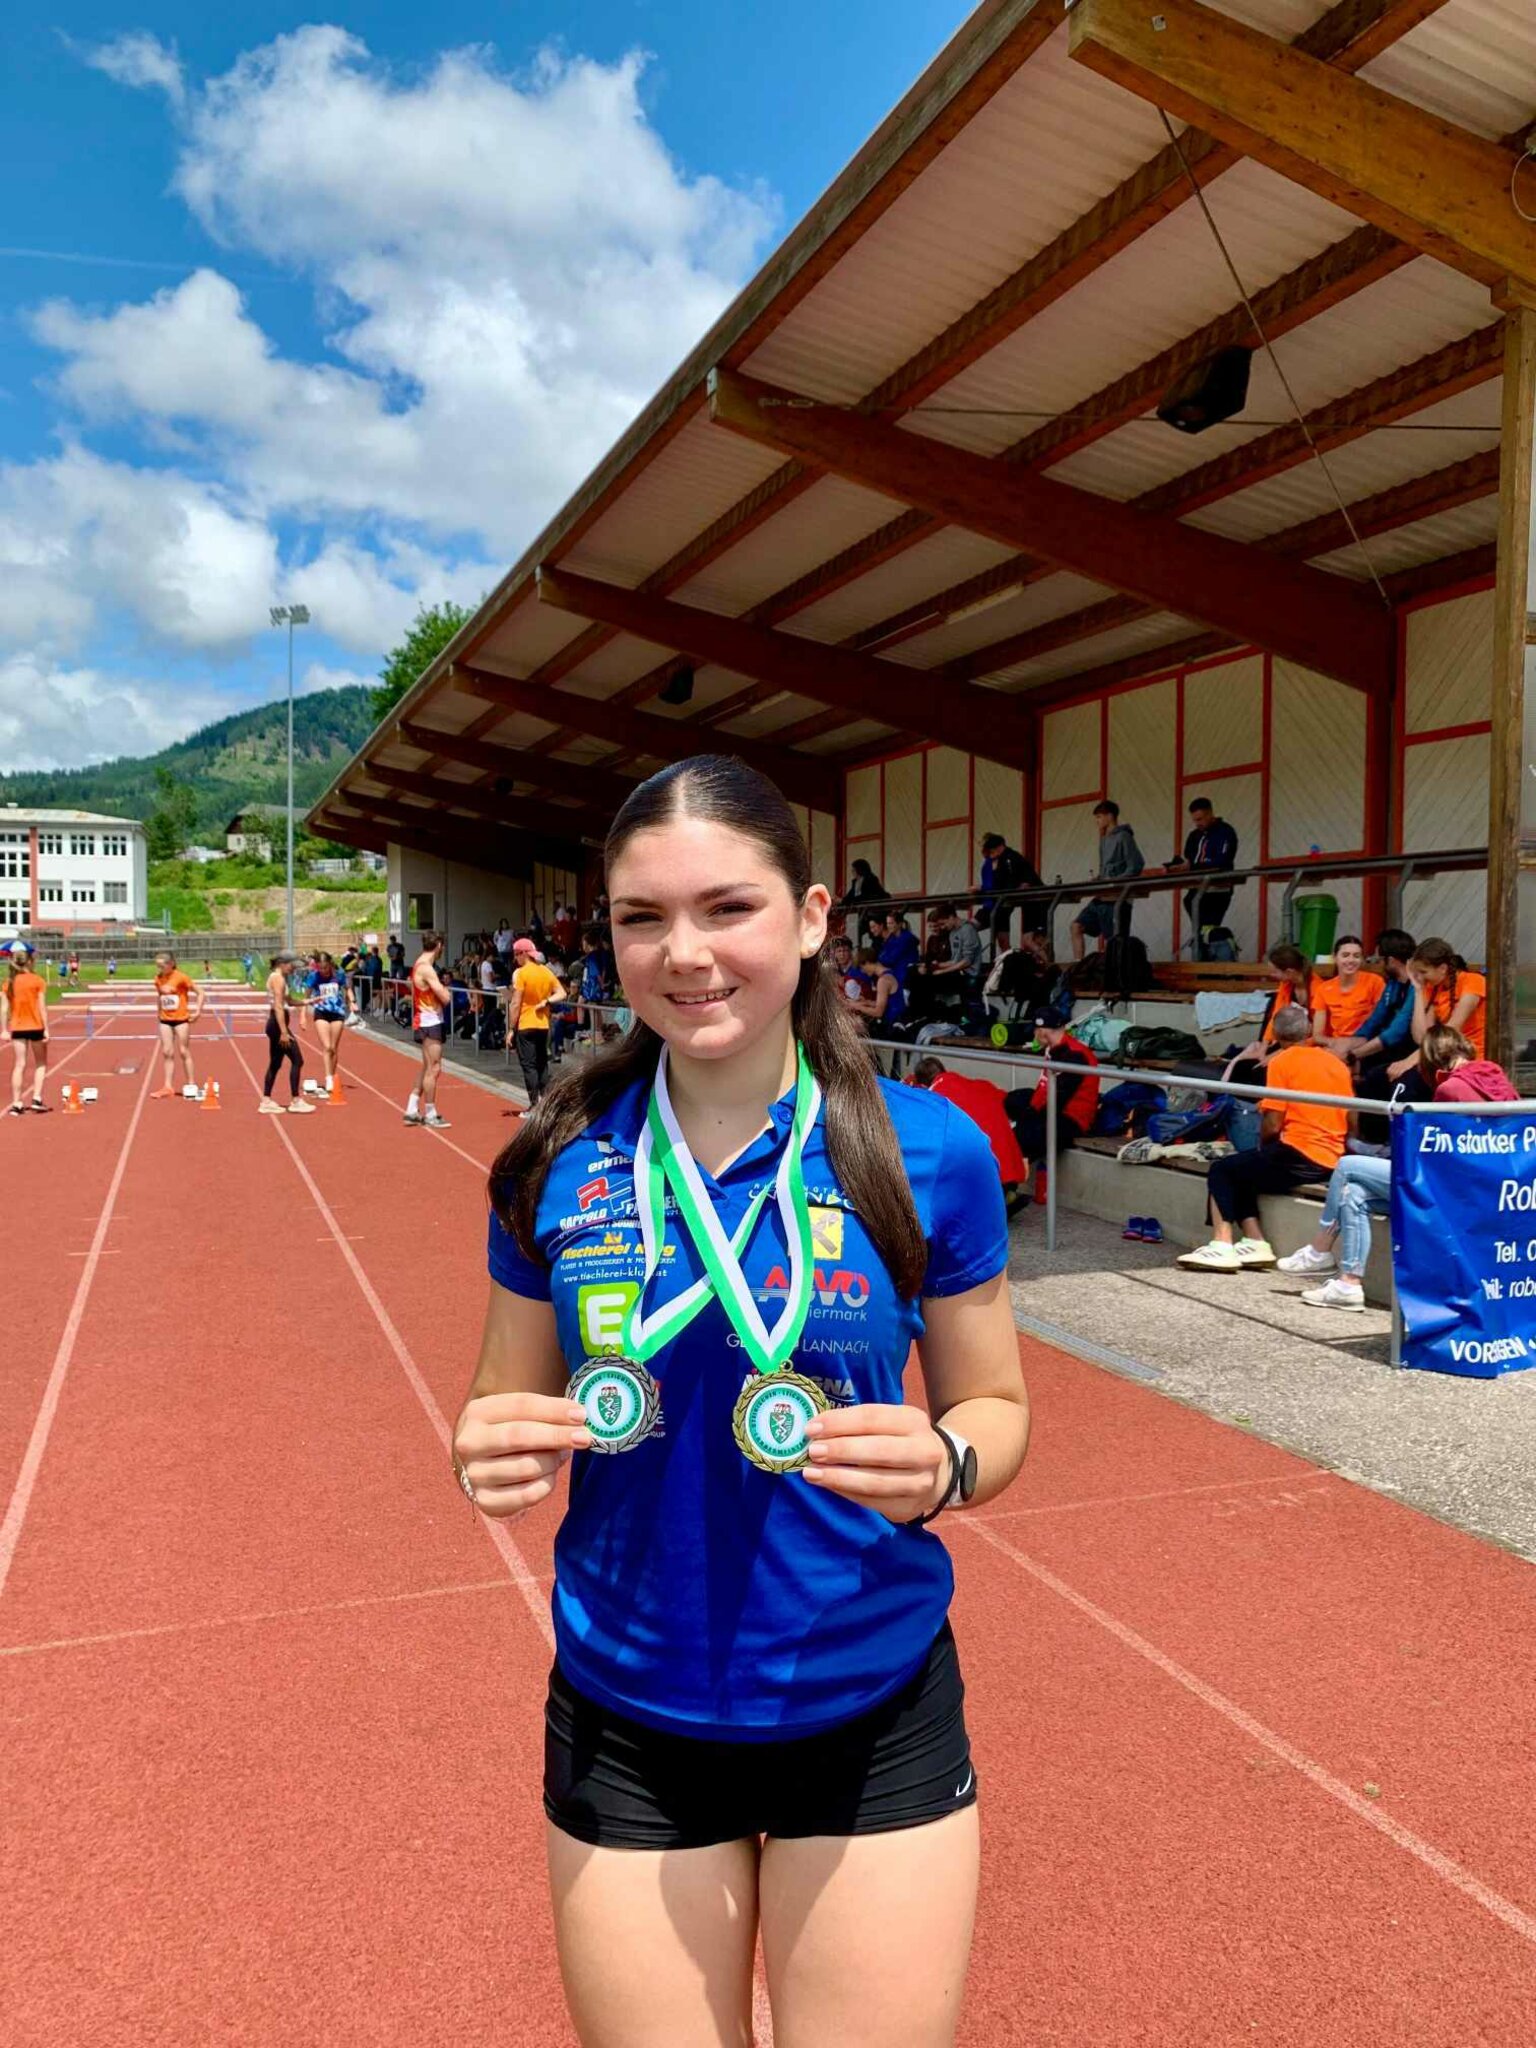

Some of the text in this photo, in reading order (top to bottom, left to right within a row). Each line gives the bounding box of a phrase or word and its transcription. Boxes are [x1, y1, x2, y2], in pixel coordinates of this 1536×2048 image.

[1419, 1126, 1536, 1154] Ein starker P
[1493, 1241, 1521, 1263] Tel.
[563, 1266, 668, 1283] www.tischlerei-klu.at
[1509, 1276, 1536, 1297] rob
[585, 1293, 626, 1346] E
[809, 1305, 868, 1321] iermark
[803, 1339, 870, 1354] LANNACH
